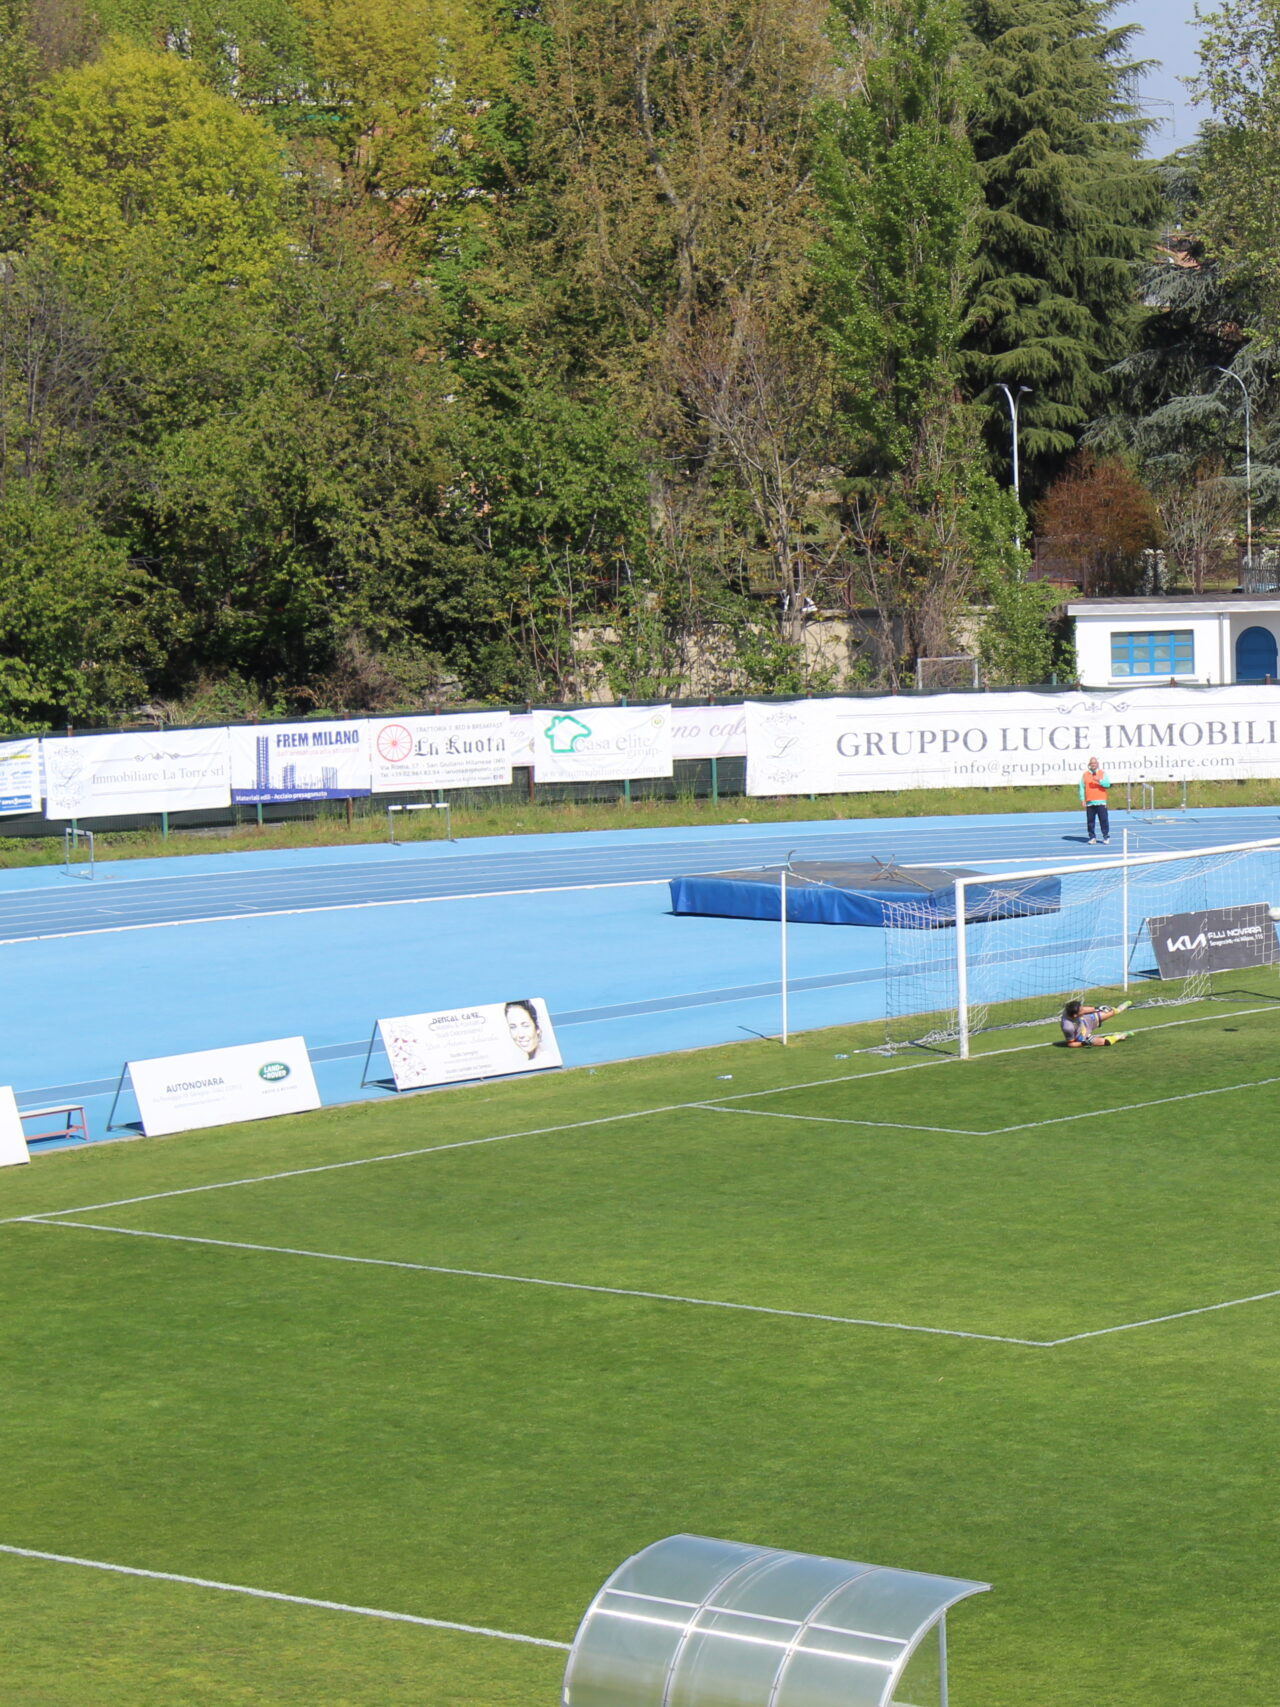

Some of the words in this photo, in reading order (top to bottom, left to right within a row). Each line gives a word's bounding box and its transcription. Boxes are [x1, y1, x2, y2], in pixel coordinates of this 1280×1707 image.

[276, 733, 309, 748] FREM
[312, 729, 360, 747] MILANO
[836, 728, 988, 758] GRUPPO
[999, 726, 1091, 752] LUCE
[91, 771, 159, 785] Immobiliare
[162, 769, 176, 780] La
[178, 767, 207, 779] Torre
[211, 764, 224, 776] srl
[954, 757, 1235, 777] info@gruppolucmmobiliare.com
[1226, 925, 1262, 937] NOVARA
[264, 1064, 280, 1073] LAND
[267, 1070, 286, 1079] ROVER
[166, 1077, 225, 1093] AUTONOVARA
